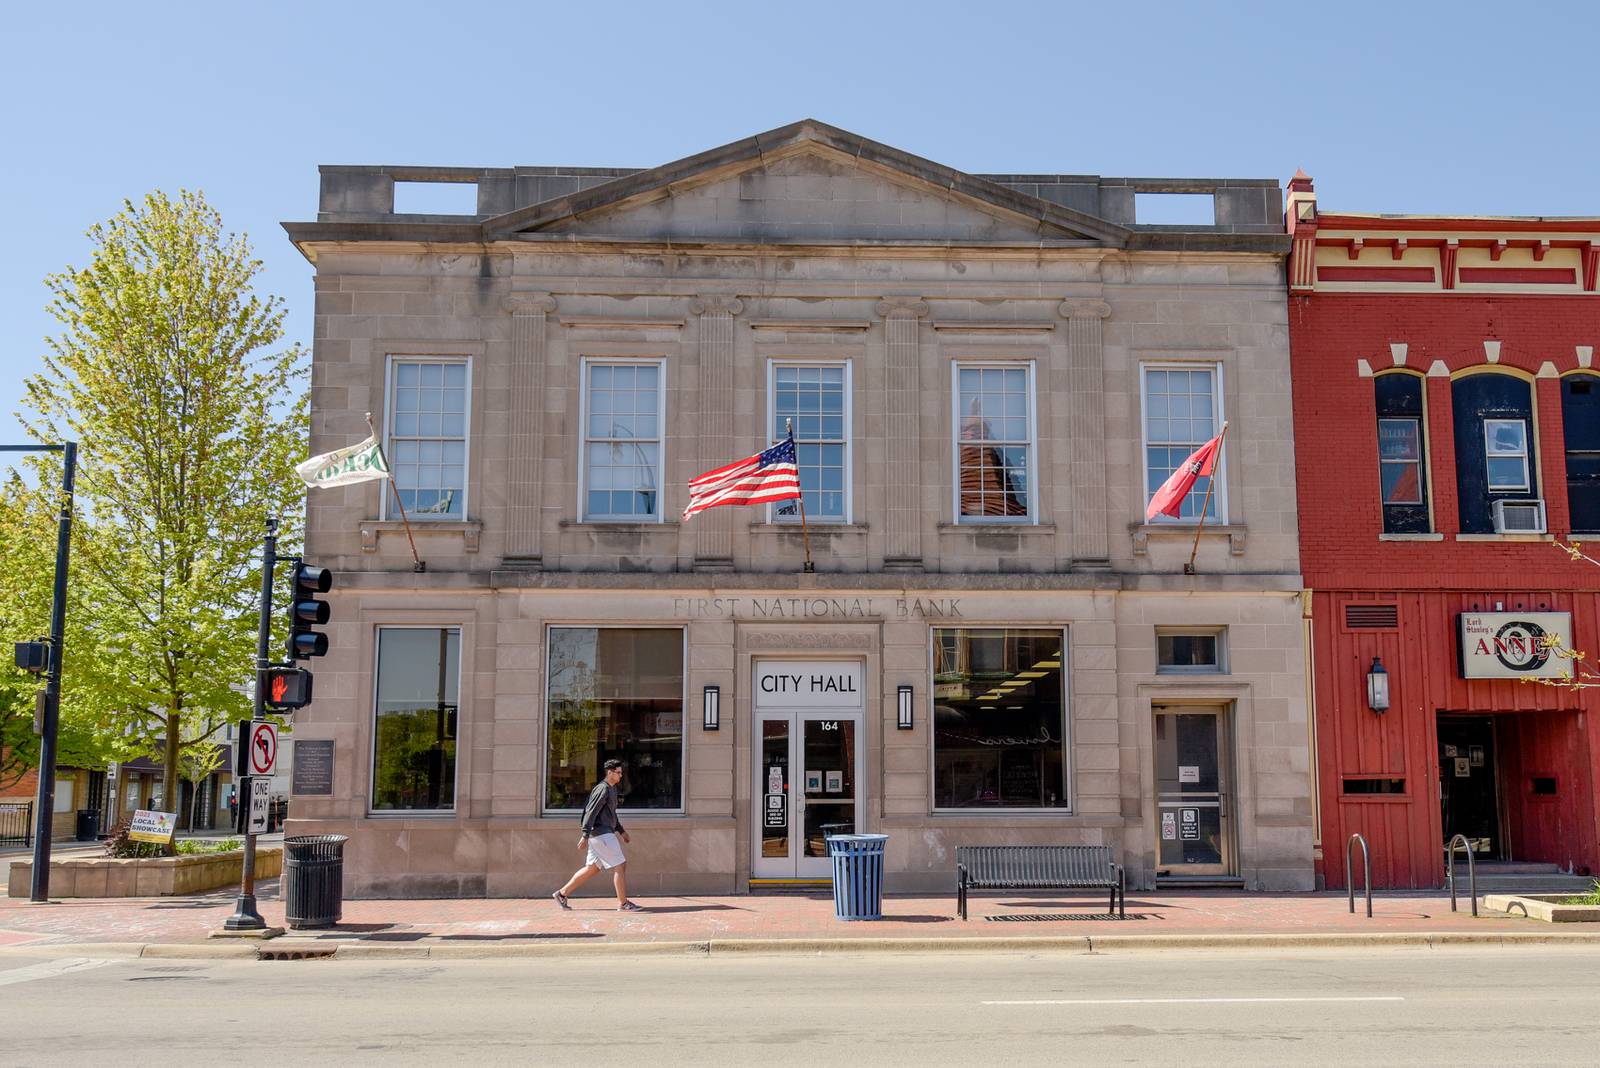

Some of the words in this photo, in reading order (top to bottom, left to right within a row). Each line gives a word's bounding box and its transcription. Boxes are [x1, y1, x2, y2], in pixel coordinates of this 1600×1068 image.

[673, 598, 739, 617] FIRST
[752, 598, 880, 617] NATIONAL
[896, 598, 963, 617] BANK
[1474, 637, 1550, 659] ANNE
[761, 674, 802, 692] CITY
[810, 674, 856, 692] HALL
[820, 721, 838, 731] 164
[254, 782, 268, 795] ONE
[253, 799, 268, 811] WAY
[131, 824, 170, 834] SHOWCASE
